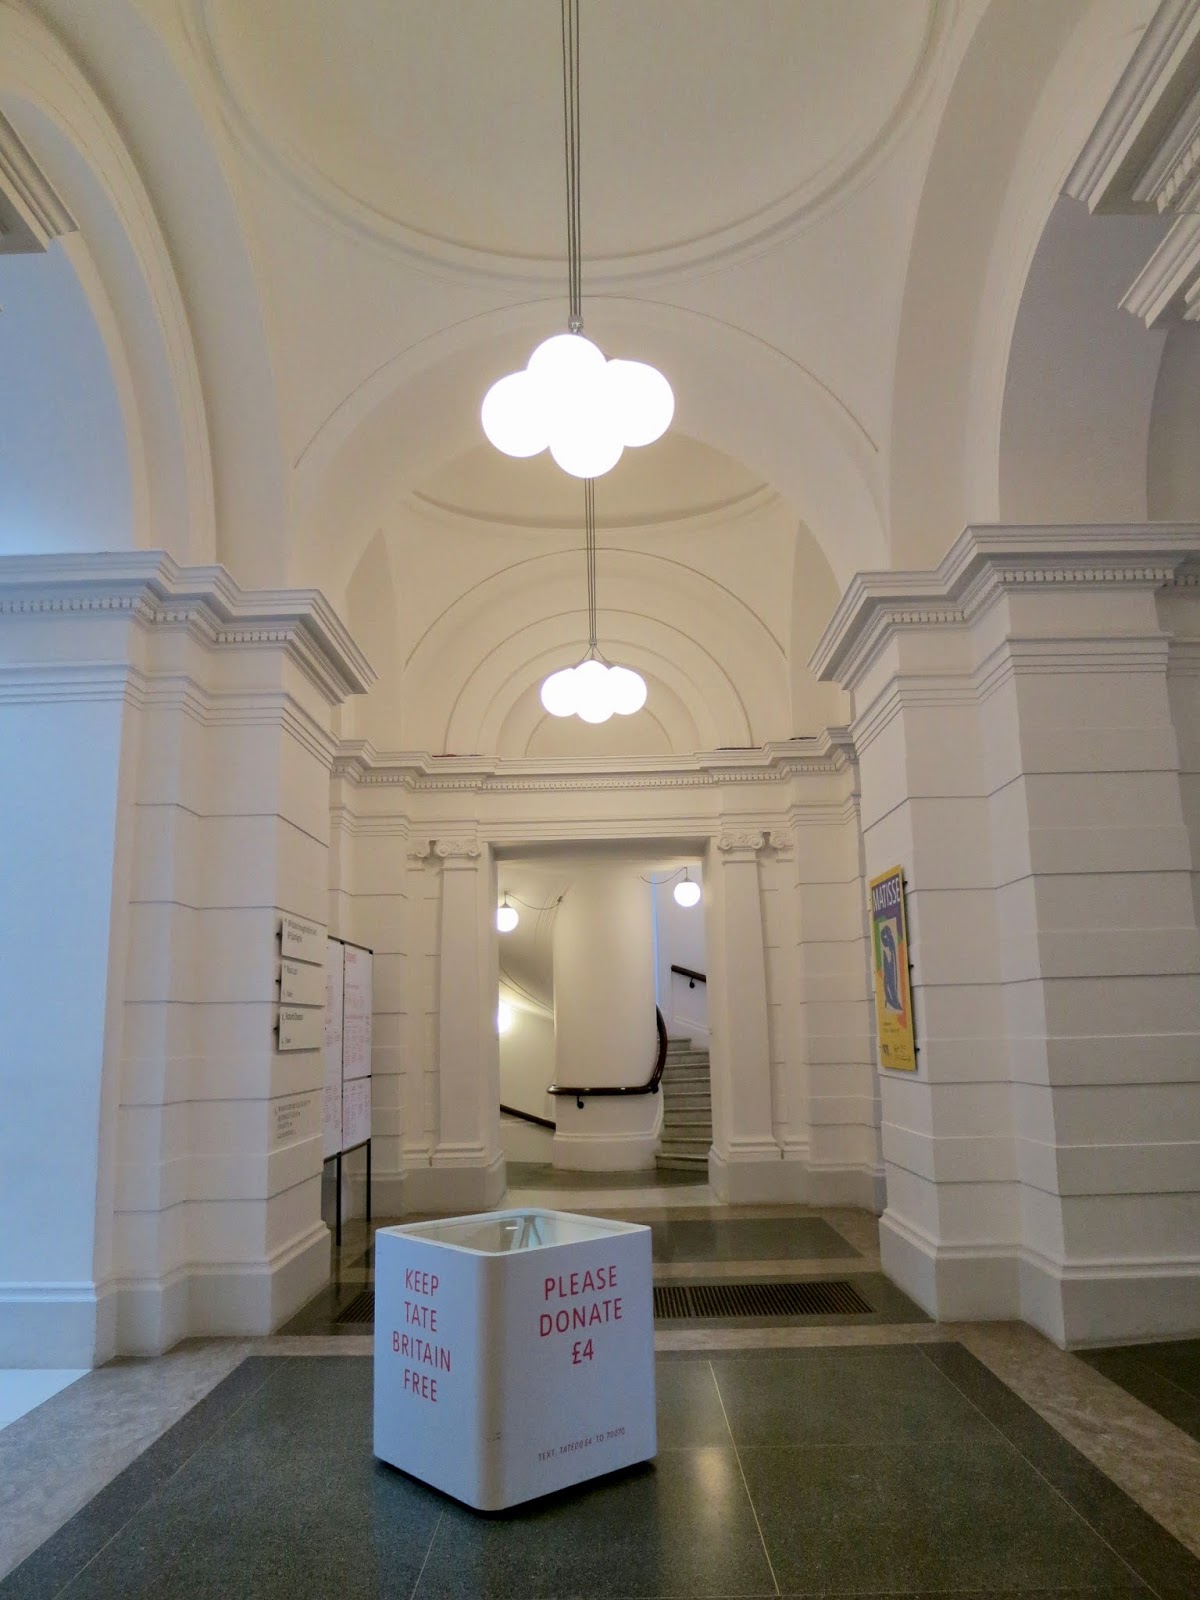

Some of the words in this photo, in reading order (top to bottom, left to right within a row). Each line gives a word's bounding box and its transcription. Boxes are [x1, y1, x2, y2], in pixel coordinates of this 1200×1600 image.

[872, 877, 900, 912] MATISSE
[405, 1268, 439, 1296] KEEP
[544, 1265, 618, 1300] PLEASE
[404, 1301, 437, 1332] TATE
[540, 1298, 622, 1337] DONATE
[393, 1331, 451, 1372] BRITAIN
[572, 1339, 594, 1364] £4
[404, 1369, 437, 1402] FREE
[538, 1449, 555, 1461] TEXT
[596, 1434, 604, 1443] TO
